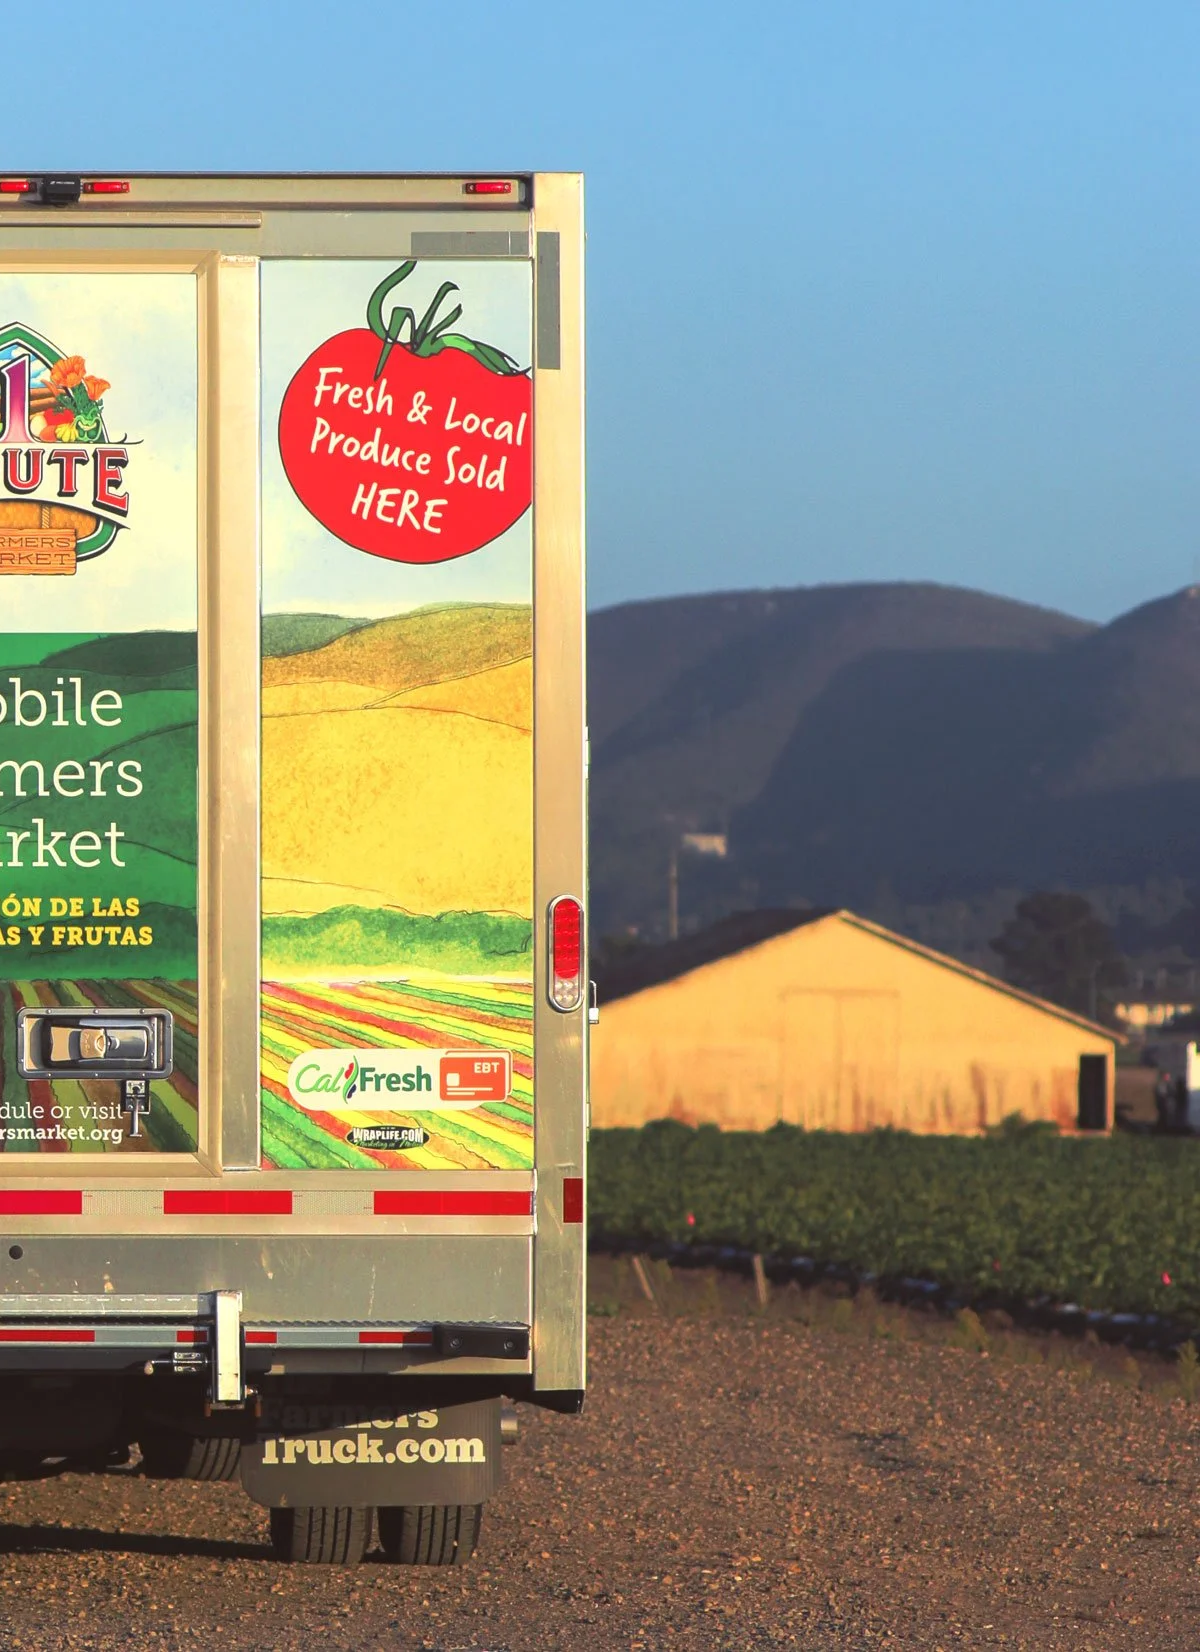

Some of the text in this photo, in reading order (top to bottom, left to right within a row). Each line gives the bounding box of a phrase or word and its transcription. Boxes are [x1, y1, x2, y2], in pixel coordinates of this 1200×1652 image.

[313, 366, 527, 446] Fresh & Local
[310, 417, 507, 492] Produce Sold
[351, 482, 448, 534] HERE
[49, 898, 85, 917] DE
[91, 898, 140, 917] LAS
[28, 926, 45, 945] Y
[52, 926, 153, 945] FRUTAS
[473, 1062, 500, 1074] EBT
[50, 1106, 71, 1120] or
[78, 1102, 124, 1120] visit
[353, 1127, 424, 1143] WRAPLIFE.COM
[258, 1433, 486, 1464] Truck.com
